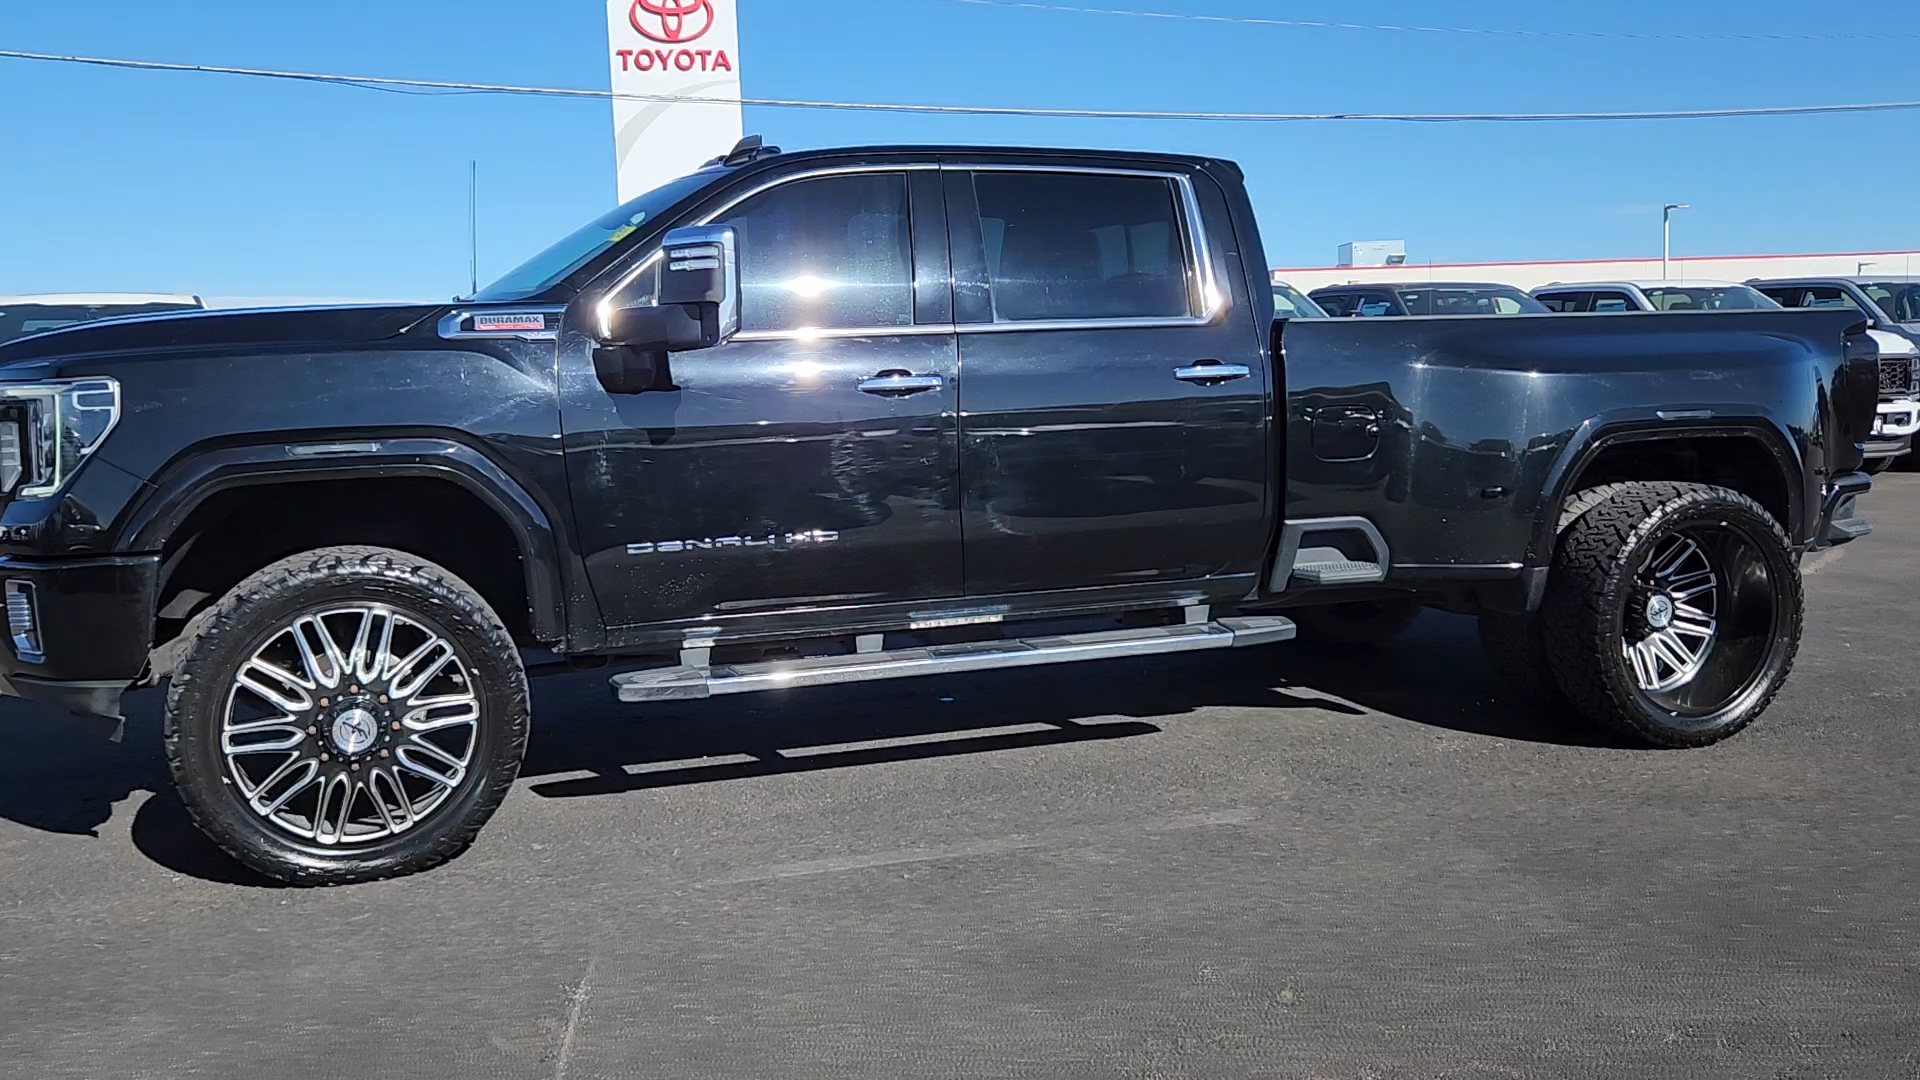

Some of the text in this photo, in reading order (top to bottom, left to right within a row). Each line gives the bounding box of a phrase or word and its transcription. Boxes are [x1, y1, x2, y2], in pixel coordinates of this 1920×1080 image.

[616, 49, 732, 72] TOYOTA
[479, 315, 541, 325] DURAMAX
[626, 530, 839, 554] DENALI HD
